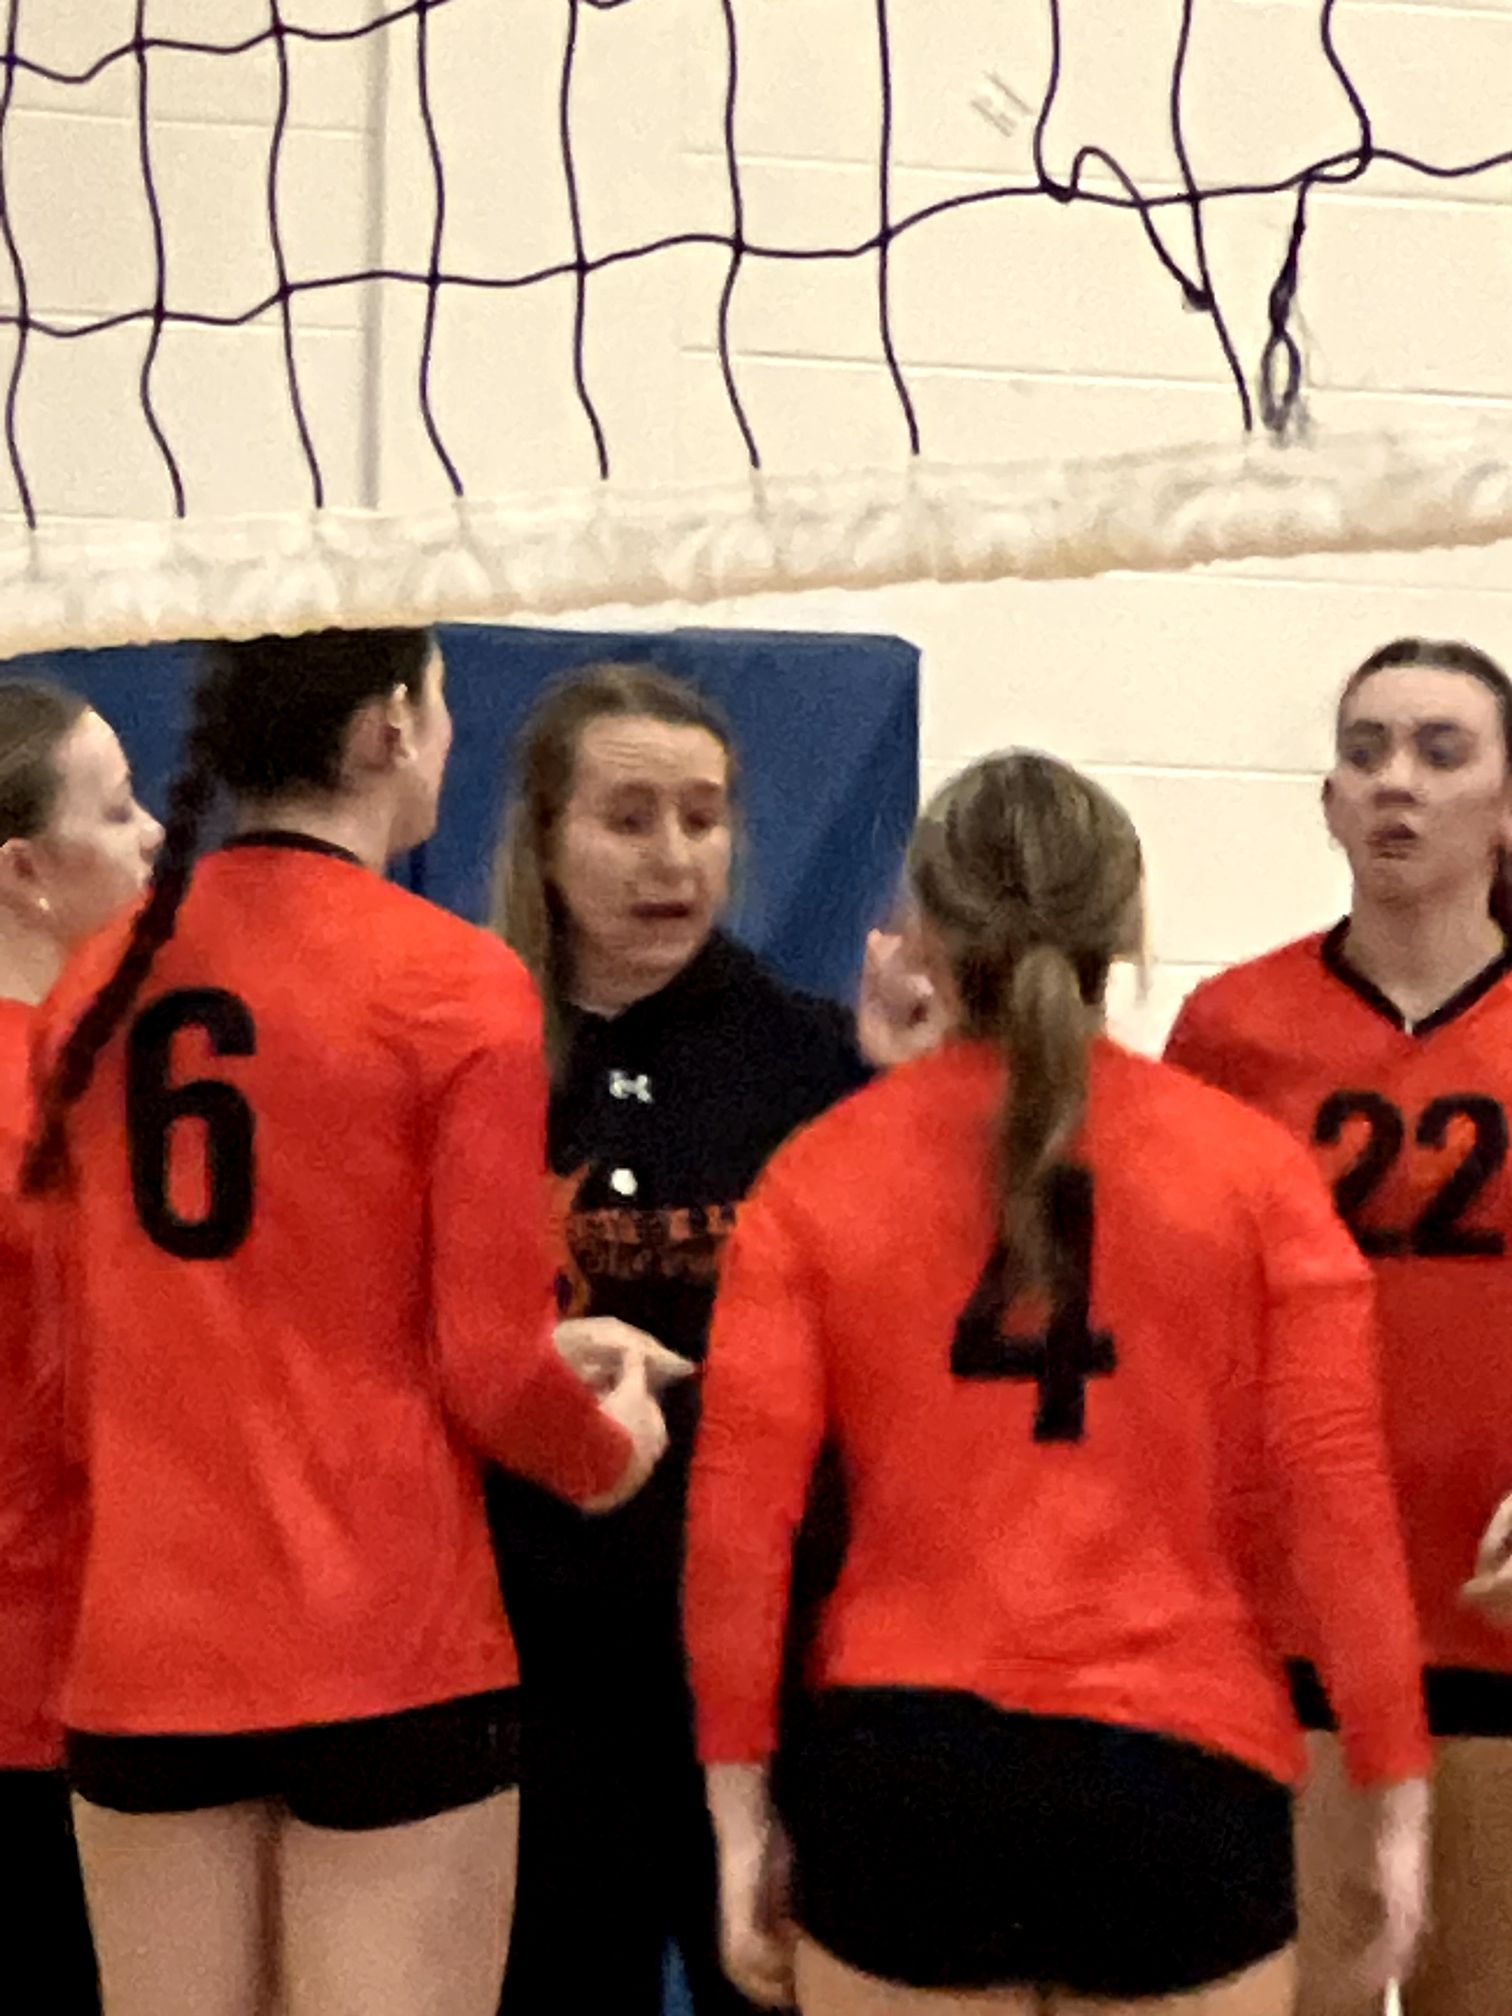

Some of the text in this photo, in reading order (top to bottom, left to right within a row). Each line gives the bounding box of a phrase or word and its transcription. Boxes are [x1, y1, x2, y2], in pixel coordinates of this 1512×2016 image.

[127, 987, 256, 1259] 6
[1312, 1090, 1509, 1256] 22
[951, 1163, 1117, 1442] 4
